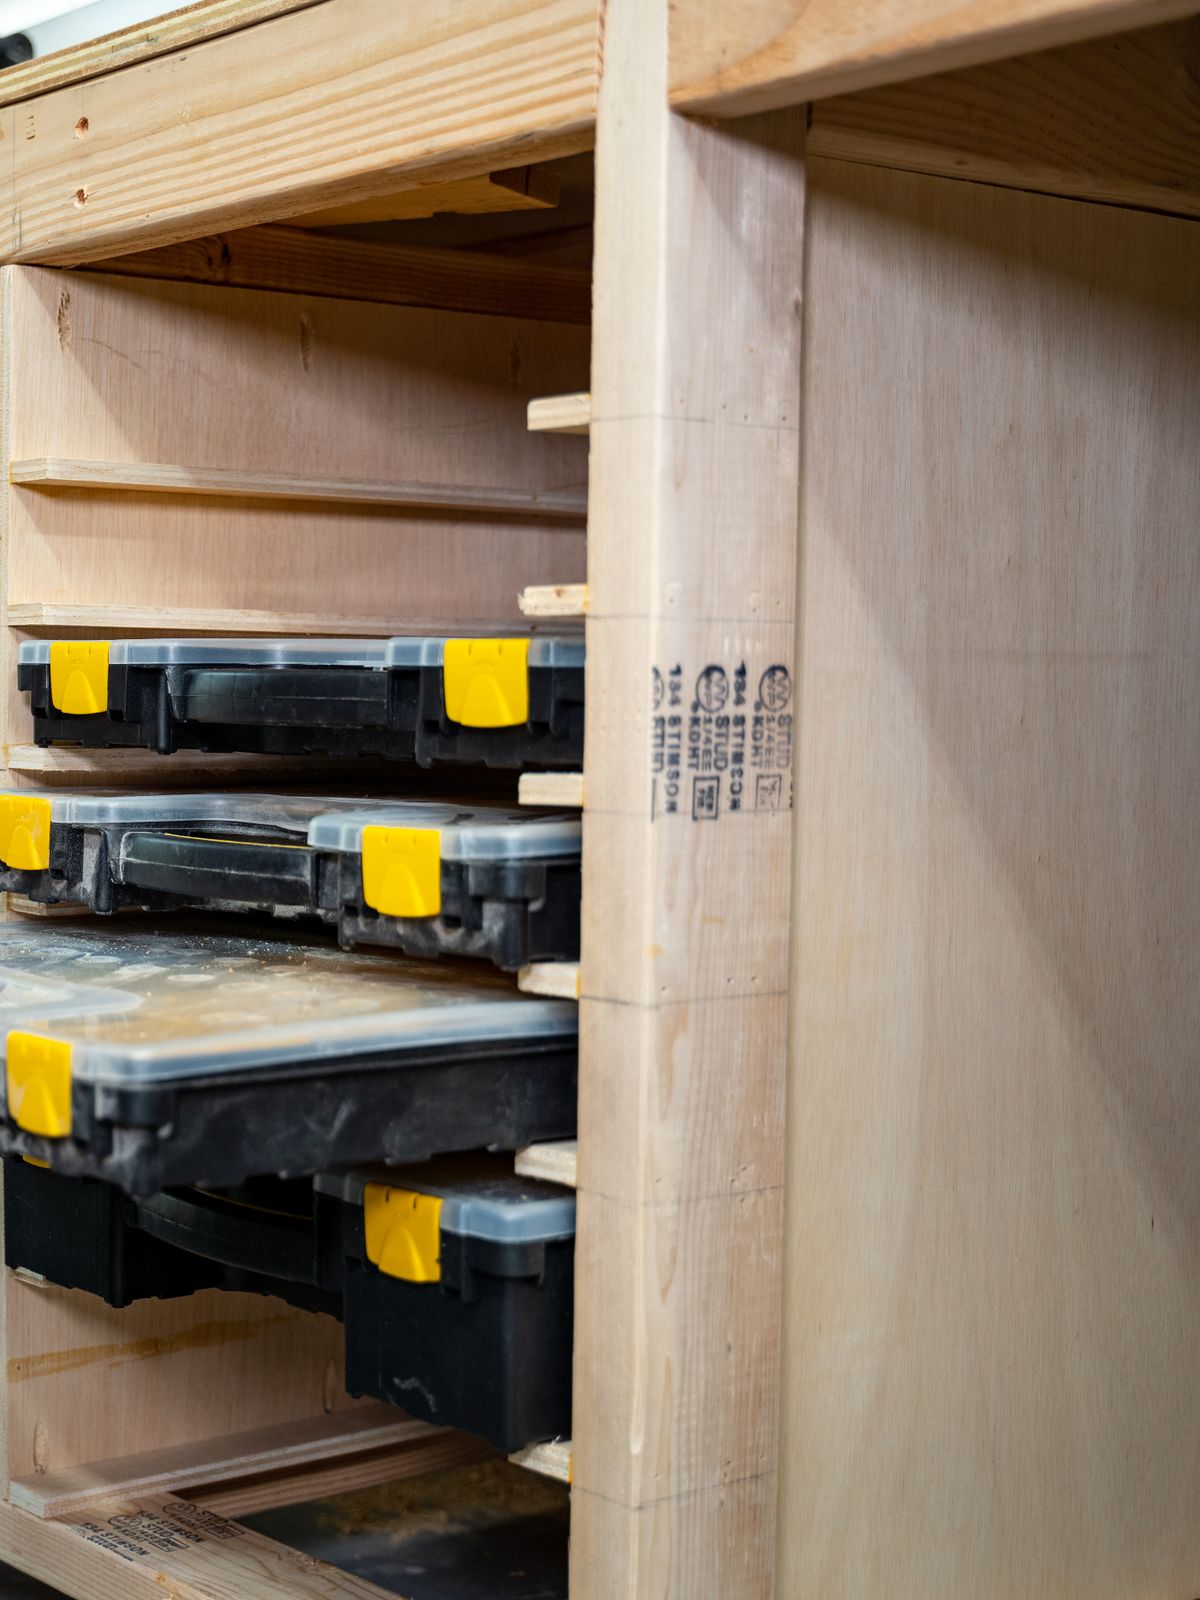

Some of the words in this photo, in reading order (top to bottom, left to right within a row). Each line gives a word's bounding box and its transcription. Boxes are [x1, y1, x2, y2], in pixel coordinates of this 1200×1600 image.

[669, 662, 682, 707] 134
[665, 715, 682, 813] STIMSON
[687, 715, 701, 771] KDHT
[702, 715, 713, 771] 1/4EE
[713, 715, 730, 772] STUD
[729, 714, 746, 811] STIMSON
[751, 715, 764, 769] KDHT
[776, 714, 793, 769] STUD
[99, 1532, 150, 1556] STIMSON
